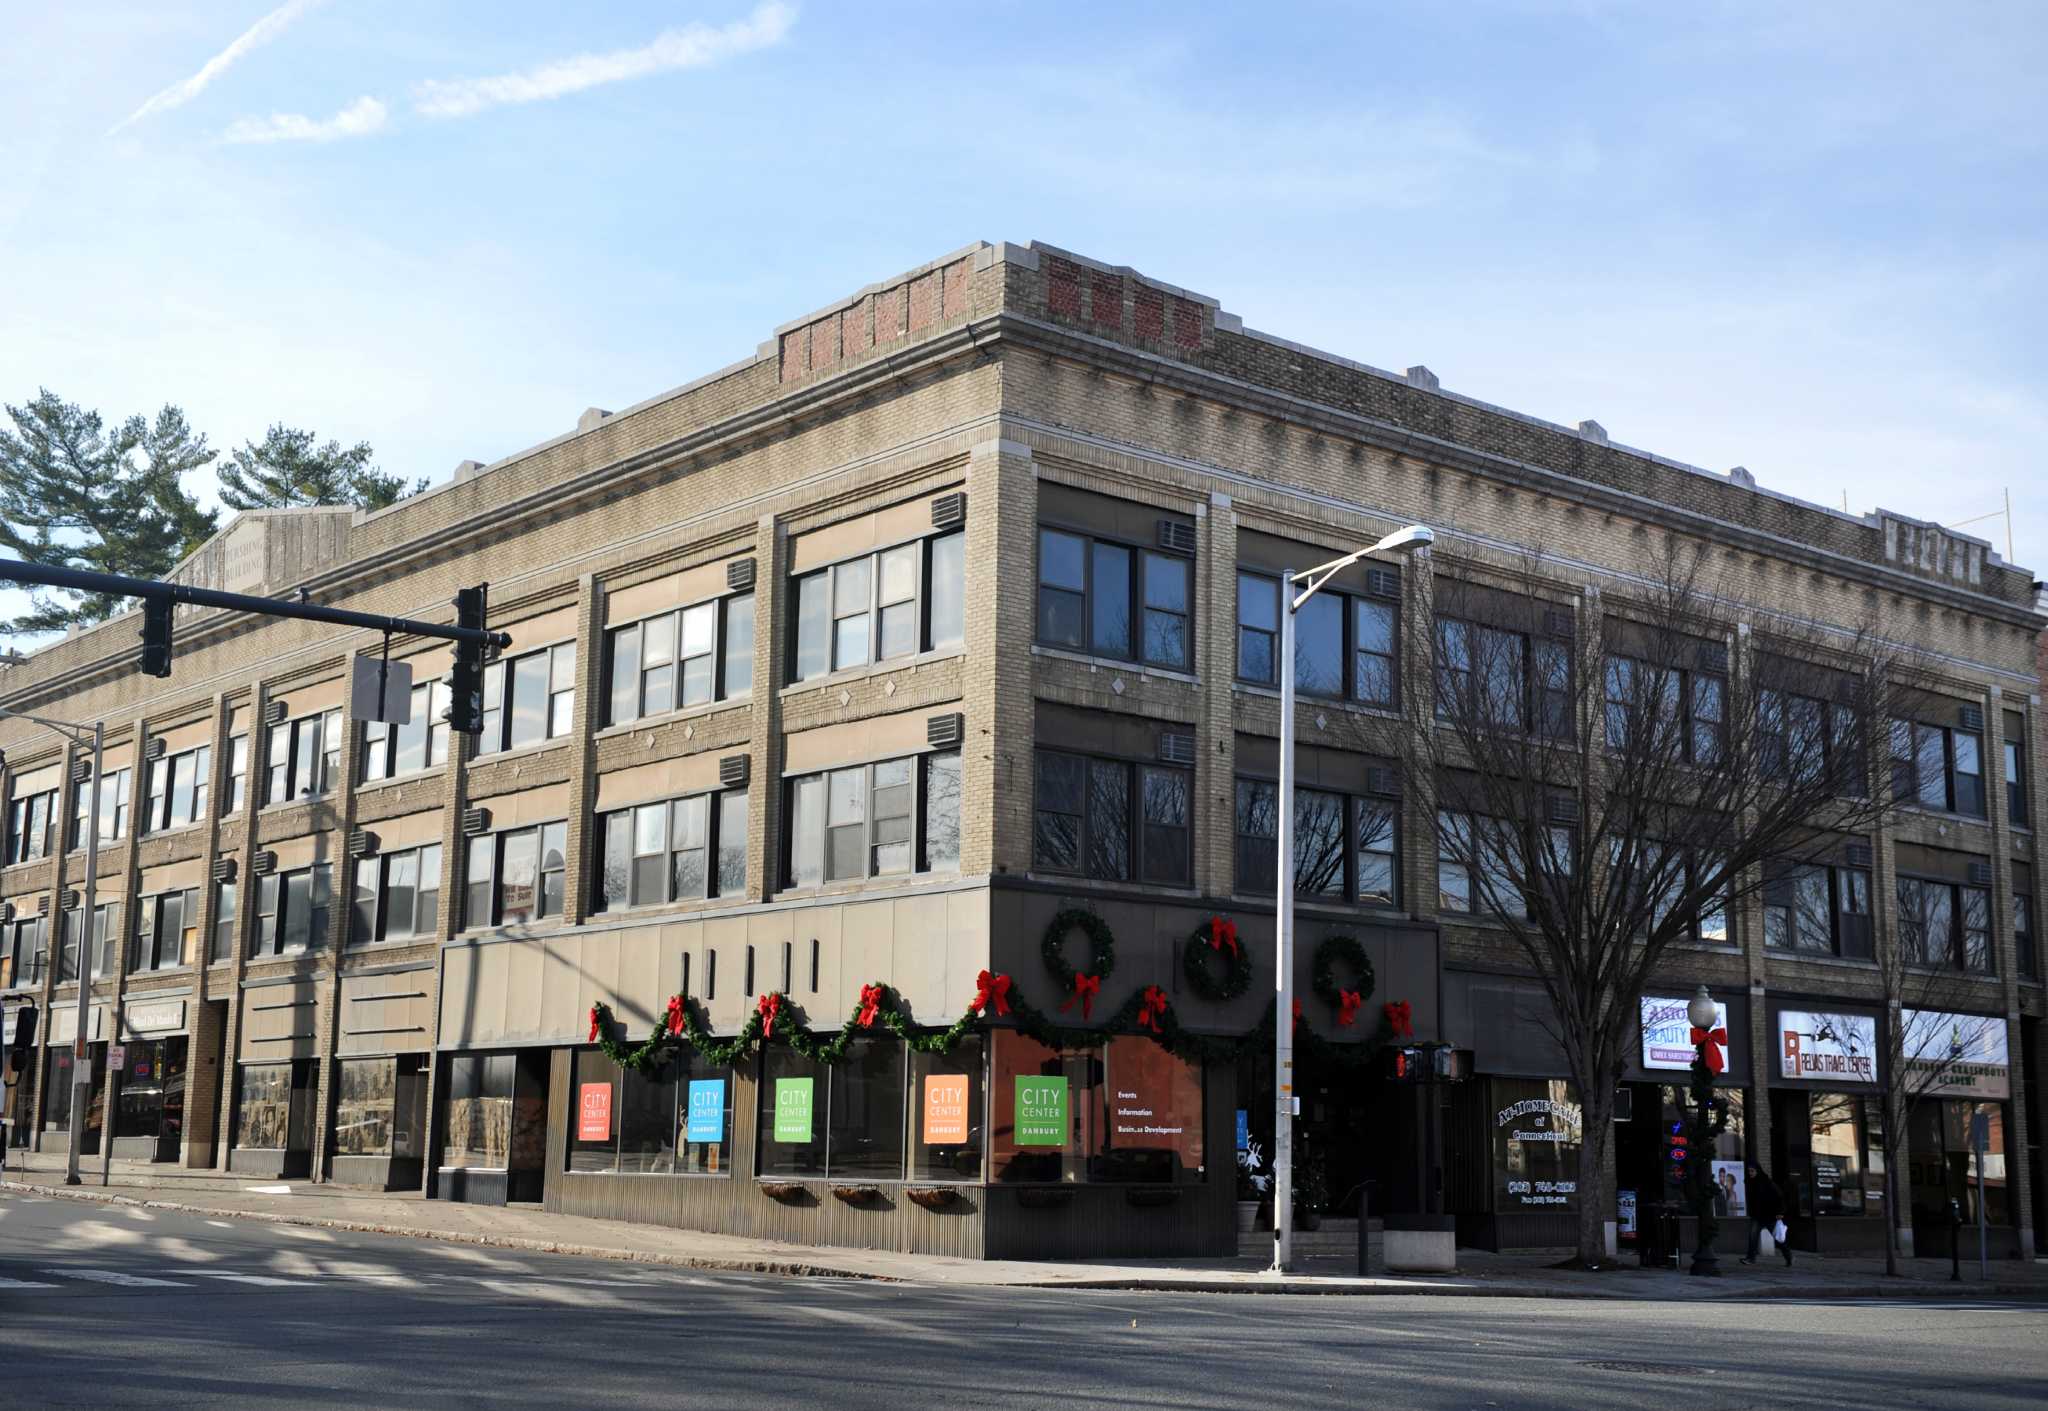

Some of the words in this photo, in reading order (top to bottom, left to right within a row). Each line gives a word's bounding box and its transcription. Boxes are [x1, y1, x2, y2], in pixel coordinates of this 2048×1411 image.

[1824, 1054, 1847, 1073] TRAVEL
[584, 1093, 607, 1108] CITY
[693, 1091, 719, 1106] CITY
[781, 1089, 808, 1105] CITY
[930, 1088, 962, 1104] CITY
[1022, 1088, 1060, 1105] CITY
[1118, 1091, 1137, 1099] Events
[583, 1109, 606, 1119] CENTER
[693, 1108, 718, 1118] CENTER
[779, 1107, 807, 1117] CENTER
[929, 1106, 961, 1117] CENTER
[1022, 1107, 1060, 1118] CENTER
[1118, 1108, 1153, 1117] Information
[1535, 1116, 1545, 1127] of
[1022, 1127, 1059, 1135] DANBURY
[1144, 1126, 1182, 1135] Development
